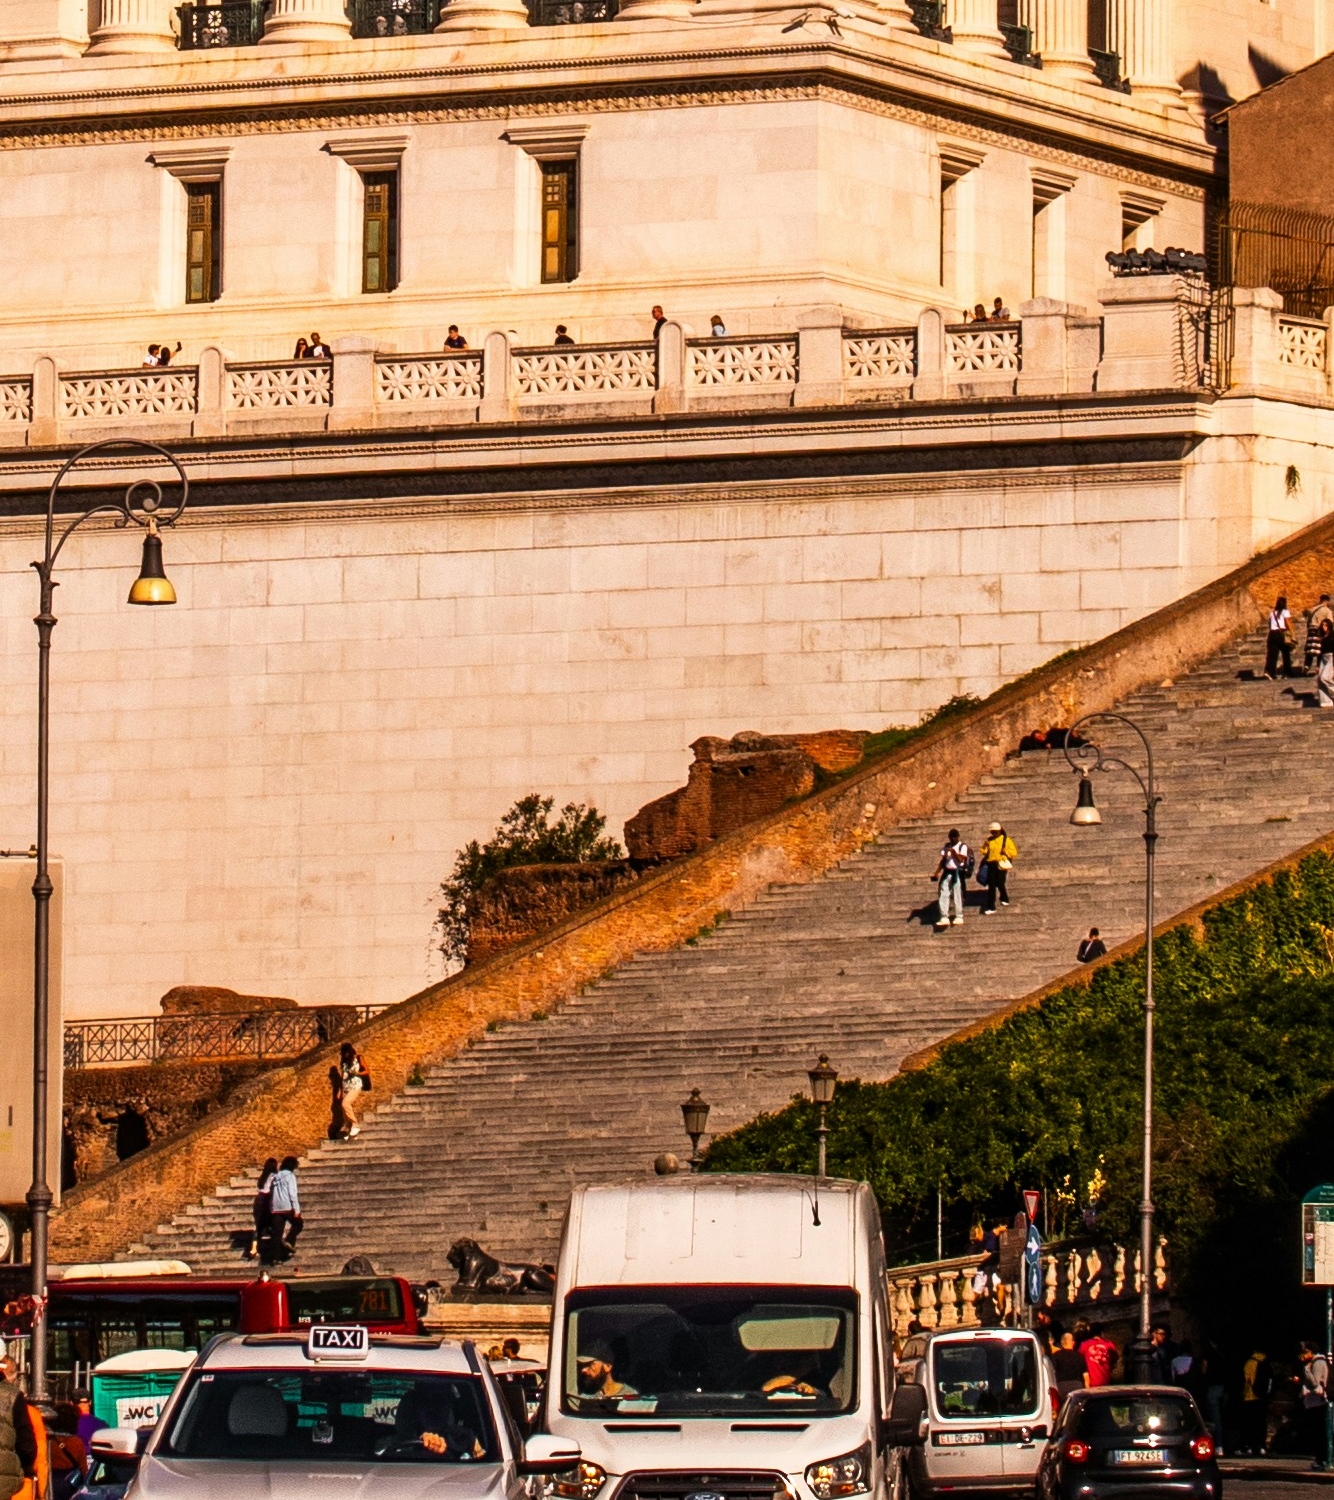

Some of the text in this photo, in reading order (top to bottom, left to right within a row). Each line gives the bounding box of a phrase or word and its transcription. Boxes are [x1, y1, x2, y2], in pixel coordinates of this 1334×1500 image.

[360, 1289, 386, 1311] 781
[317, 1330, 361, 1347] TAXI
[128, 1405, 154, 1419] WC
